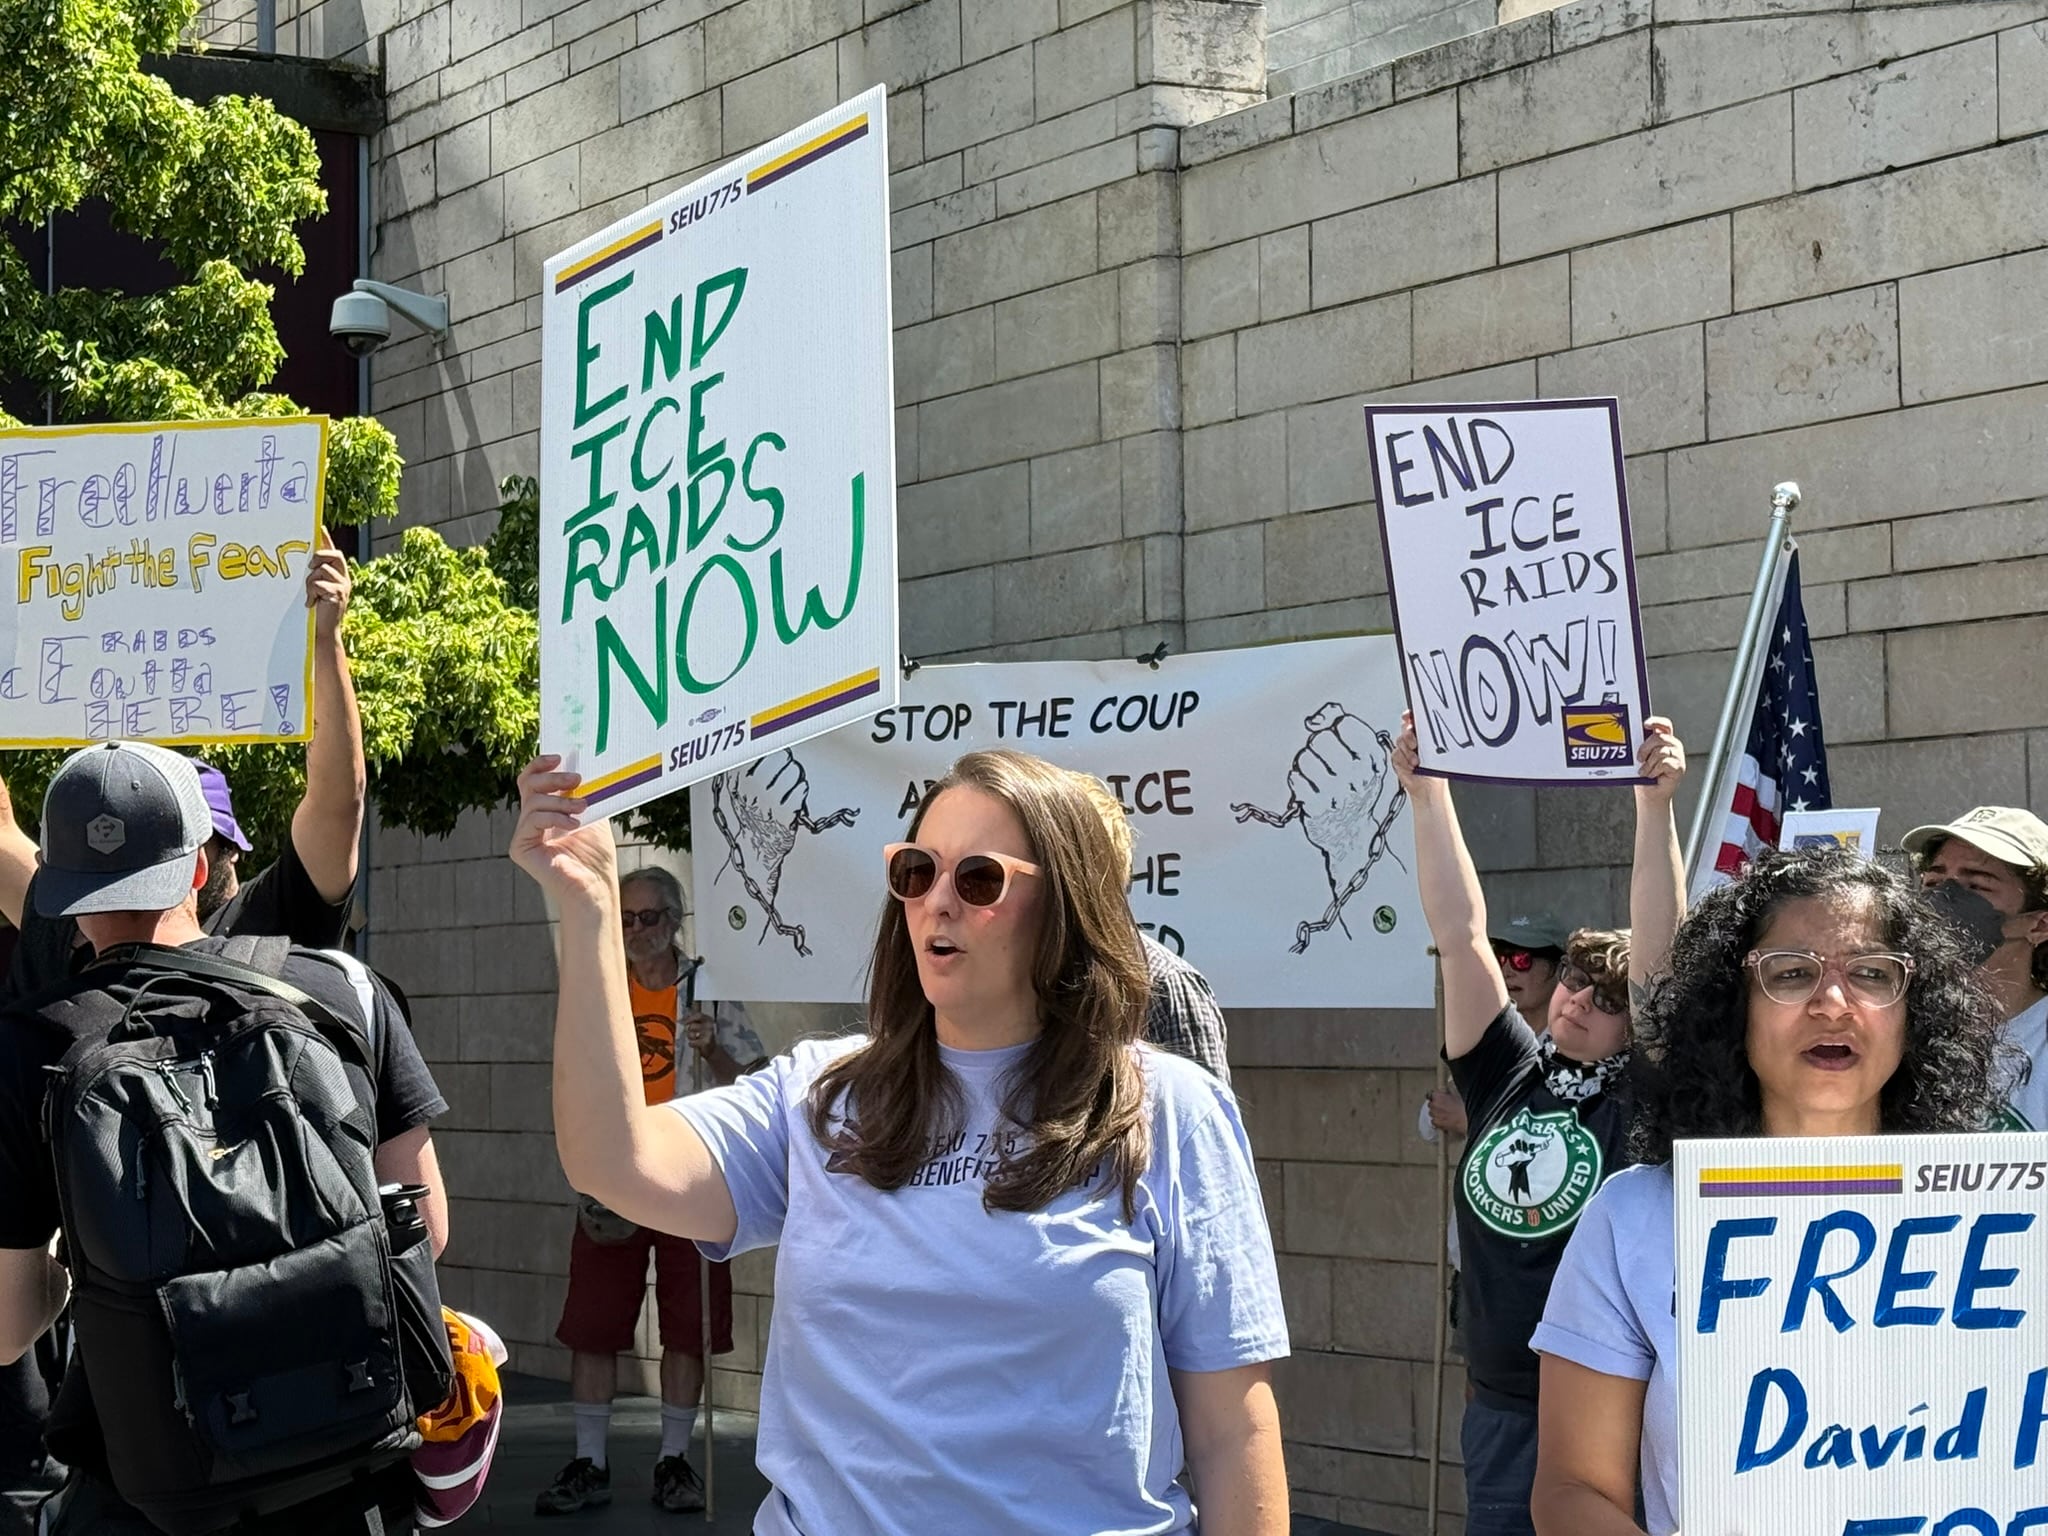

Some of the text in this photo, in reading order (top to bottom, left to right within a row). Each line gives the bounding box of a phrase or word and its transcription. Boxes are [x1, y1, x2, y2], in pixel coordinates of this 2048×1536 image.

[573, 267, 749, 430] END
[563, 371, 726, 536] ICE
[1385, 417, 1515, 508] END
[561, 431, 786, 624] RAIDS
[1465, 493, 1580, 560] ICE
[188, 532, 311, 593] Fear
[1460, 548, 1618, 616] RAIDS
[101, 628, 216, 653] RAIDS
[595, 471, 865, 757] NOW
[90, 658, 212, 700] Outta
[1408, 615, 1620, 755] NOW!
[871, 690, 1200, 744] STOP THE COUP
[1106, 769, 1195, 816] ICE
[1126, 853, 1181, 896] HE
[1542, 1161, 1592, 1221] UNITED
[1697, 1210, 2037, 1334] FREE
